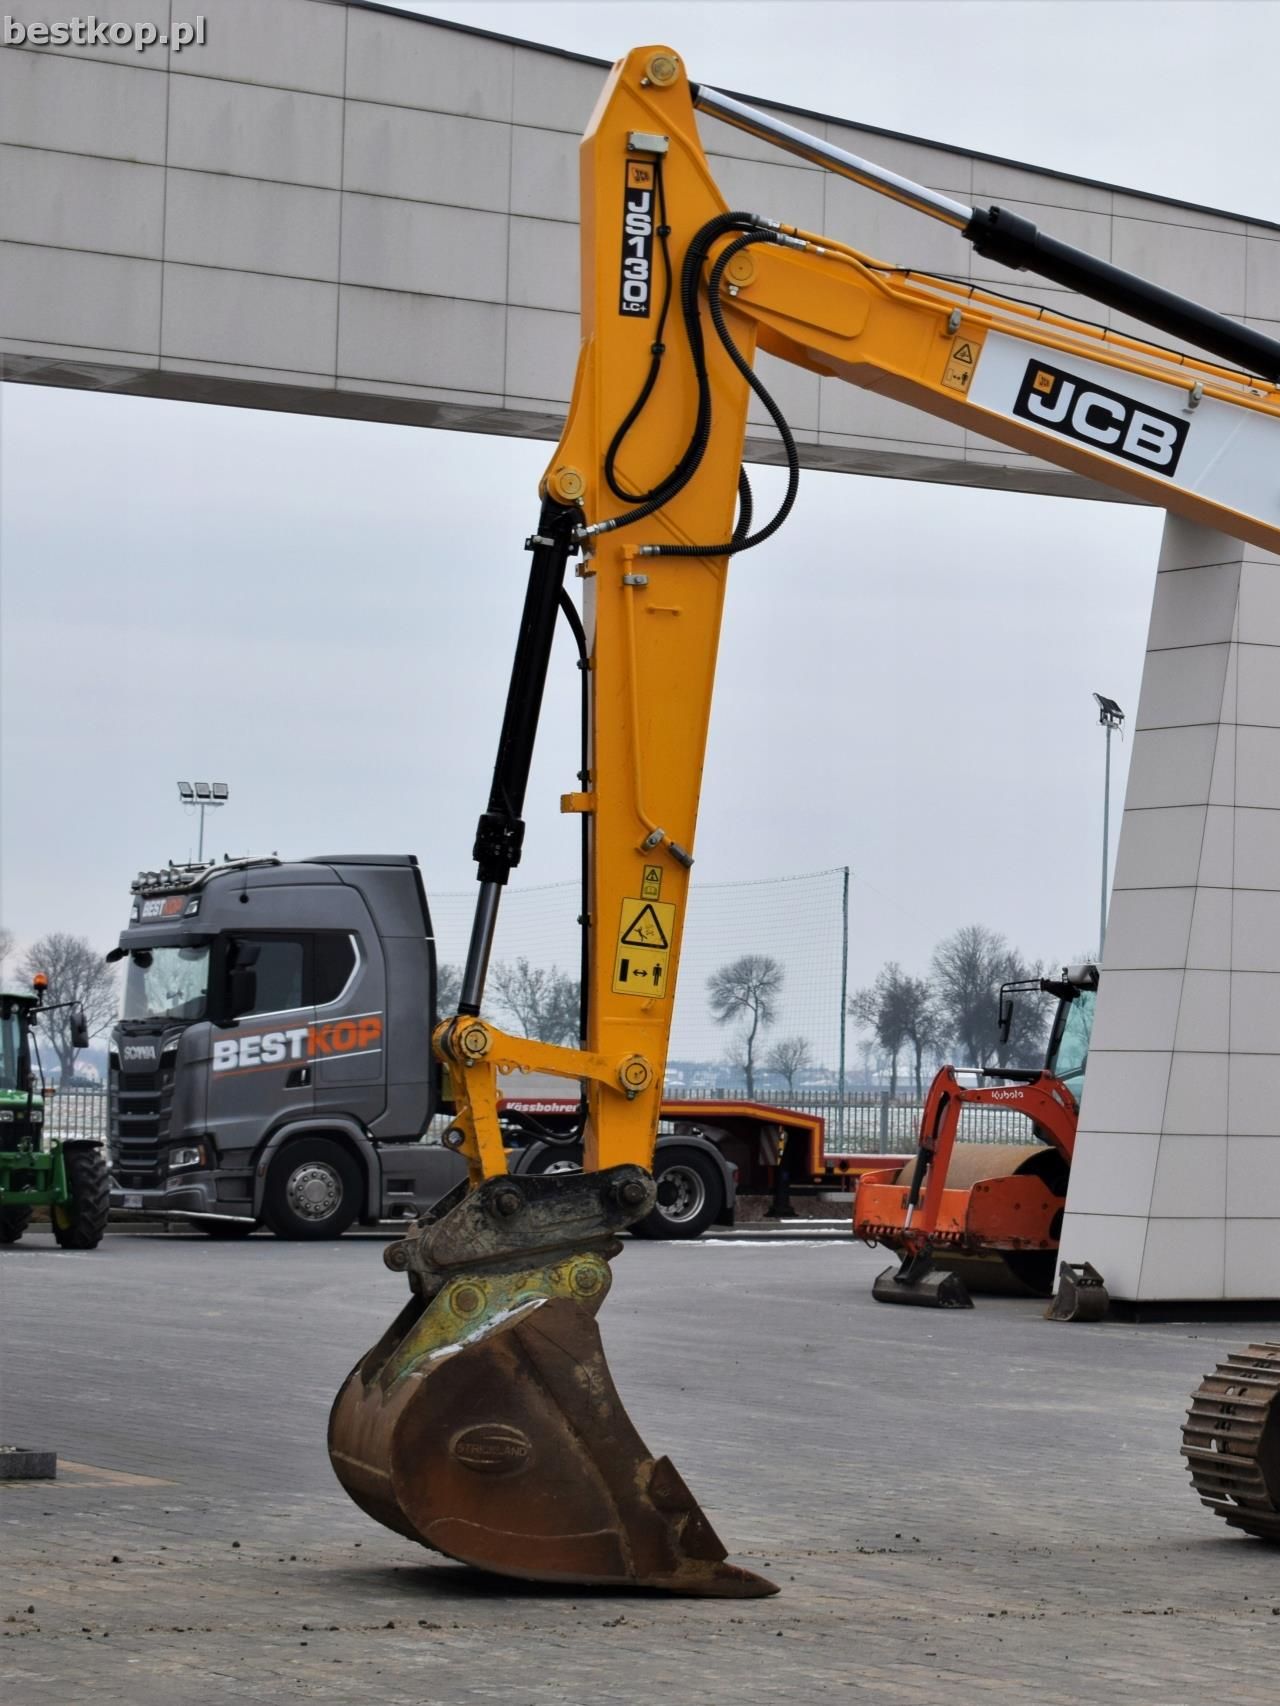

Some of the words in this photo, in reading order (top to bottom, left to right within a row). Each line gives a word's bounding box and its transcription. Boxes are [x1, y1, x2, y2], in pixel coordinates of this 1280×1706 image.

[623, 192, 652, 303] JS130
[1027, 382, 1179, 467] JCB
[212, 1016, 382, 1072] BESTKOP
